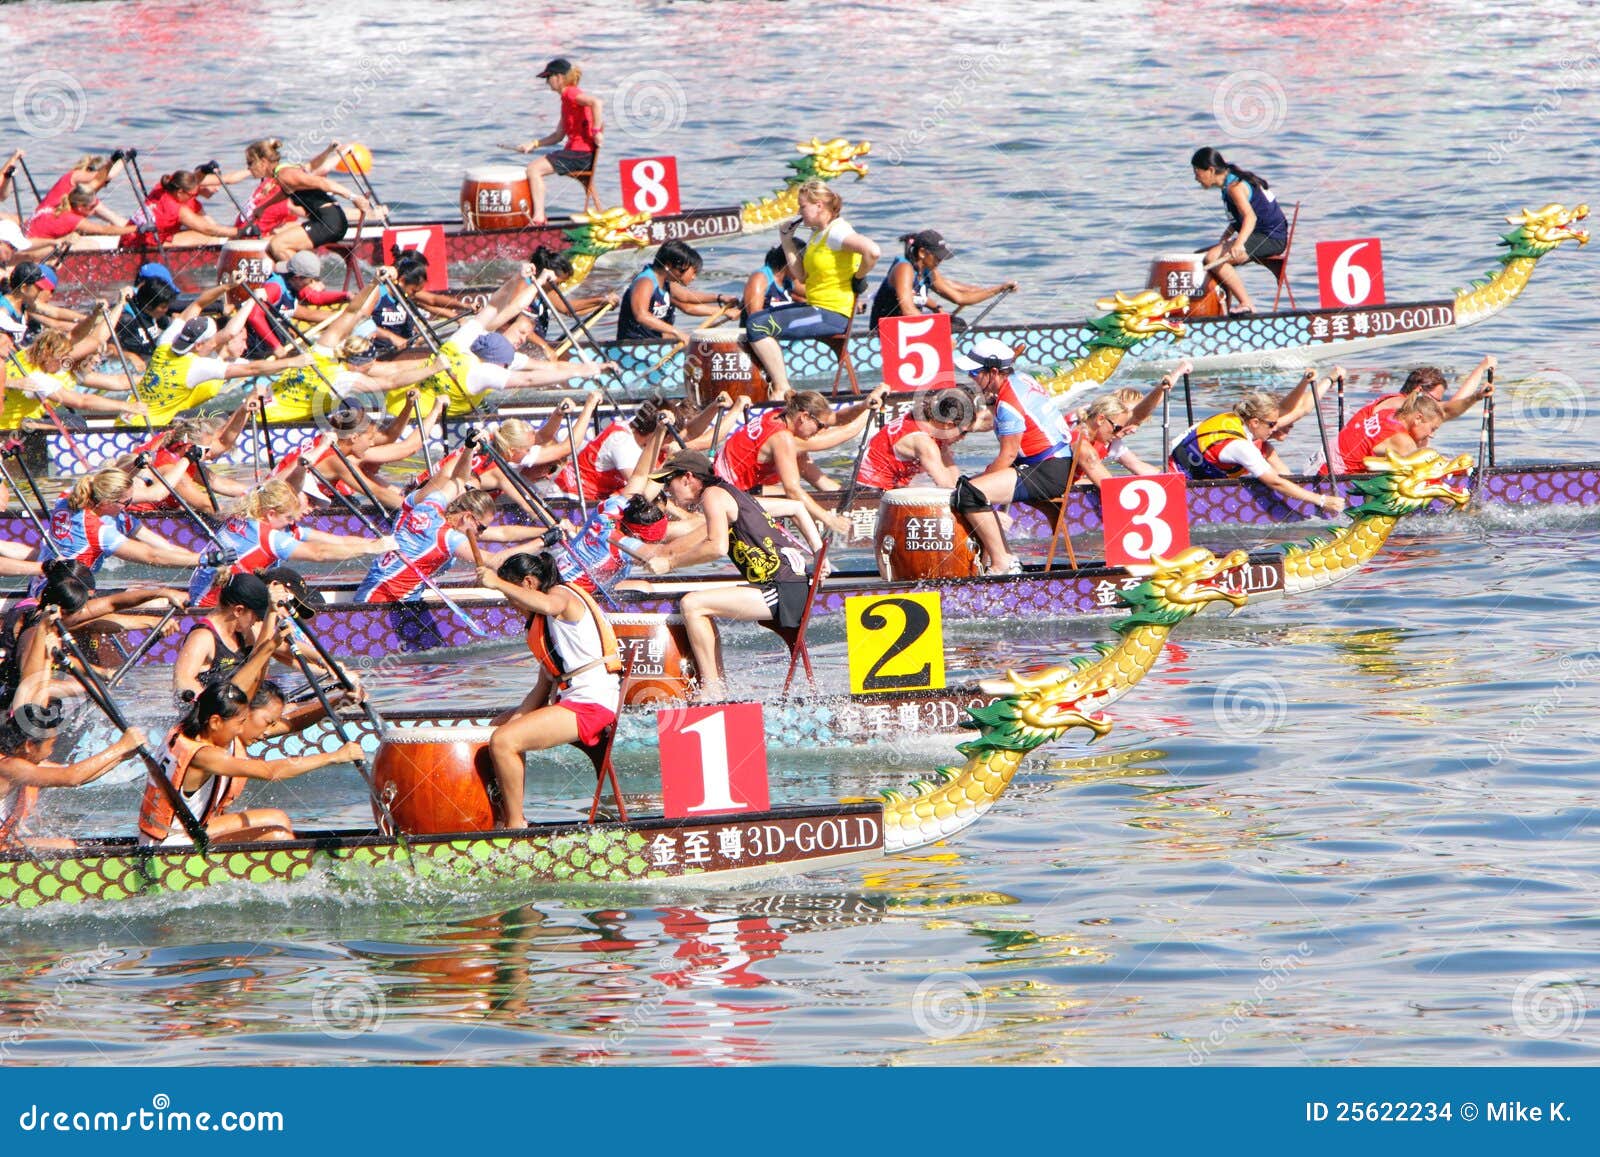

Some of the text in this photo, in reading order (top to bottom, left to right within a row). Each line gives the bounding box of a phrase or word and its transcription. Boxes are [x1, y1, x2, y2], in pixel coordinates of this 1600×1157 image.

[631, 160, 669, 212] 8
[667, 215, 740, 238] 3D-GOLD
[1331, 242, 1371, 306] 6
[1311, 306, 1453, 339] 金至尊 3D-GOLD
[711, 371, 752, 381] 3D-GOLD
[897, 318, 941, 387] 5
[906, 517, 956, 541] 金至尊
[1119, 479, 1173, 560] 3
[906, 541, 954, 551] 3D-GOLD
[860, 597, 931, 691] 2
[680, 710, 748, 812] 1
[651, 817, 879, 867] 金至尊 3D-GOLD
